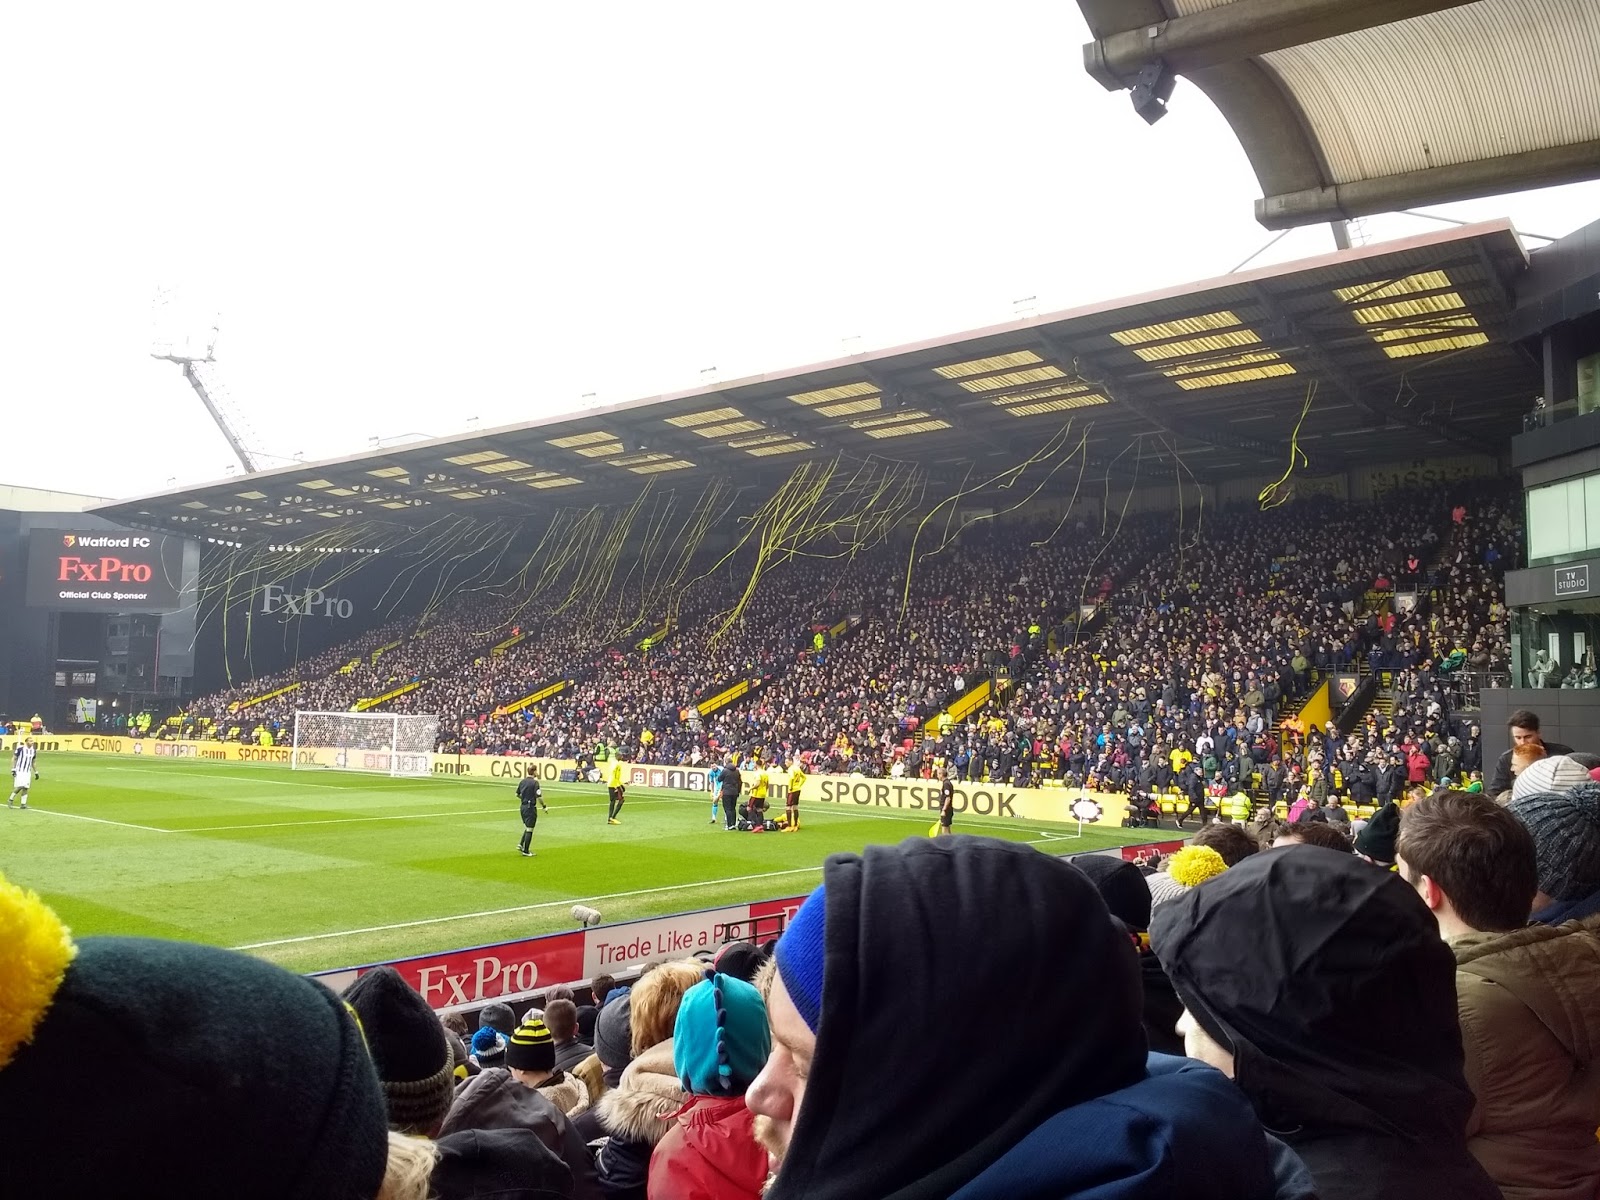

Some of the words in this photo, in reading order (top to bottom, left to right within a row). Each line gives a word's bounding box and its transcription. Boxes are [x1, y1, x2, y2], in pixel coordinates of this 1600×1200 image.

[78, 536, 129, 547] Watford
[132, 537, 151, 548] FC
[57, 556, 152, 582] FxPro
[1566, 571, 1576, 580] TV
[1558, 578, 1586, 590] STUDIO
[59, 591, 90, 599] Official
[91, 591, 112, 599] Club
[113, 592, 148, 600] Sponsor
[260, 584, 354, 619] FxPro
[81, 737, 122, 752] CASINO
[238, 748, 317, 764] SPORTSBOOK
[491, 760, 557, 780] CASINO
[820, 780, 1017, 816] SPORTSBOOK
[596, 936, 651, 965] Trade
[657, 930, 692, 954] Like
[698, 932, 707, 946] a
[416, 956, 538, 1007] FxPro
